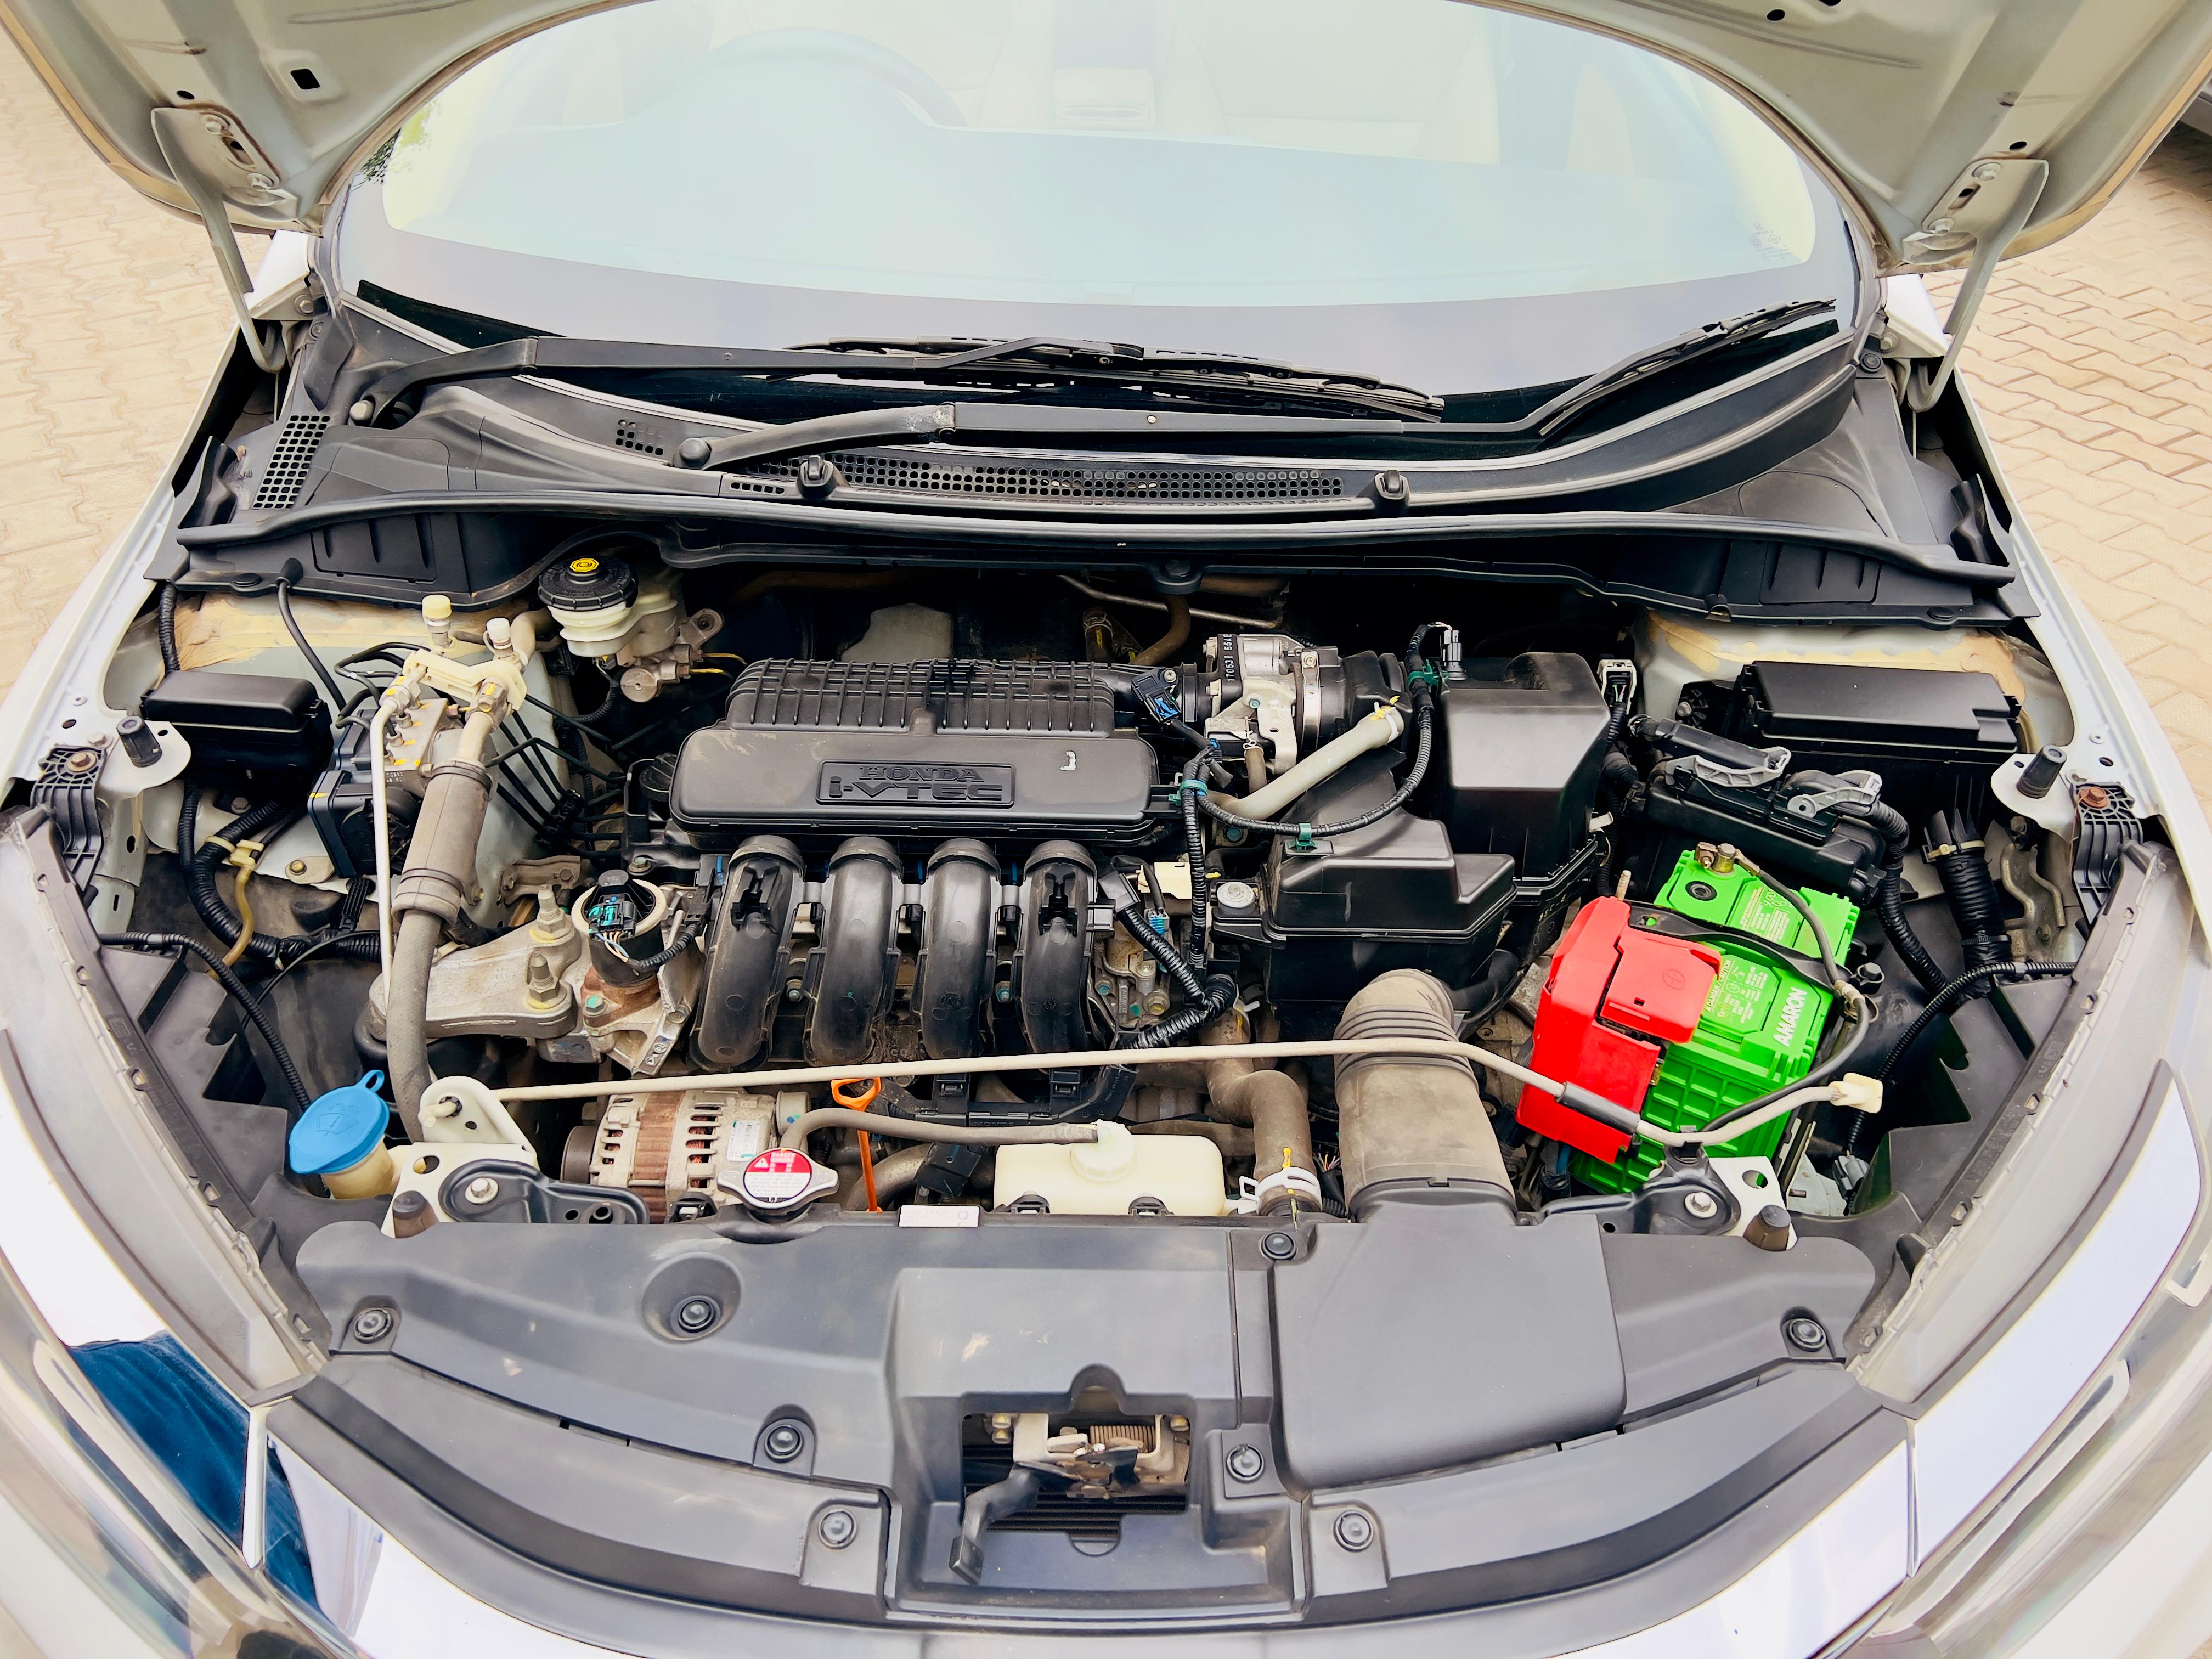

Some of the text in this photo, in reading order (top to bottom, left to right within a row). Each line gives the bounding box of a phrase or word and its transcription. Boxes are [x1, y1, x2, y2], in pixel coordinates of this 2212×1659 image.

[828, 775, 1003, 802] i-VTEC
[859, 766, 984, 782] HONDA
[1706, 985, 1720, 1007] DANGER
[1718, 958, 1733, 983] CAUTION
[1772, 987, 1808, 1047] AMARON
